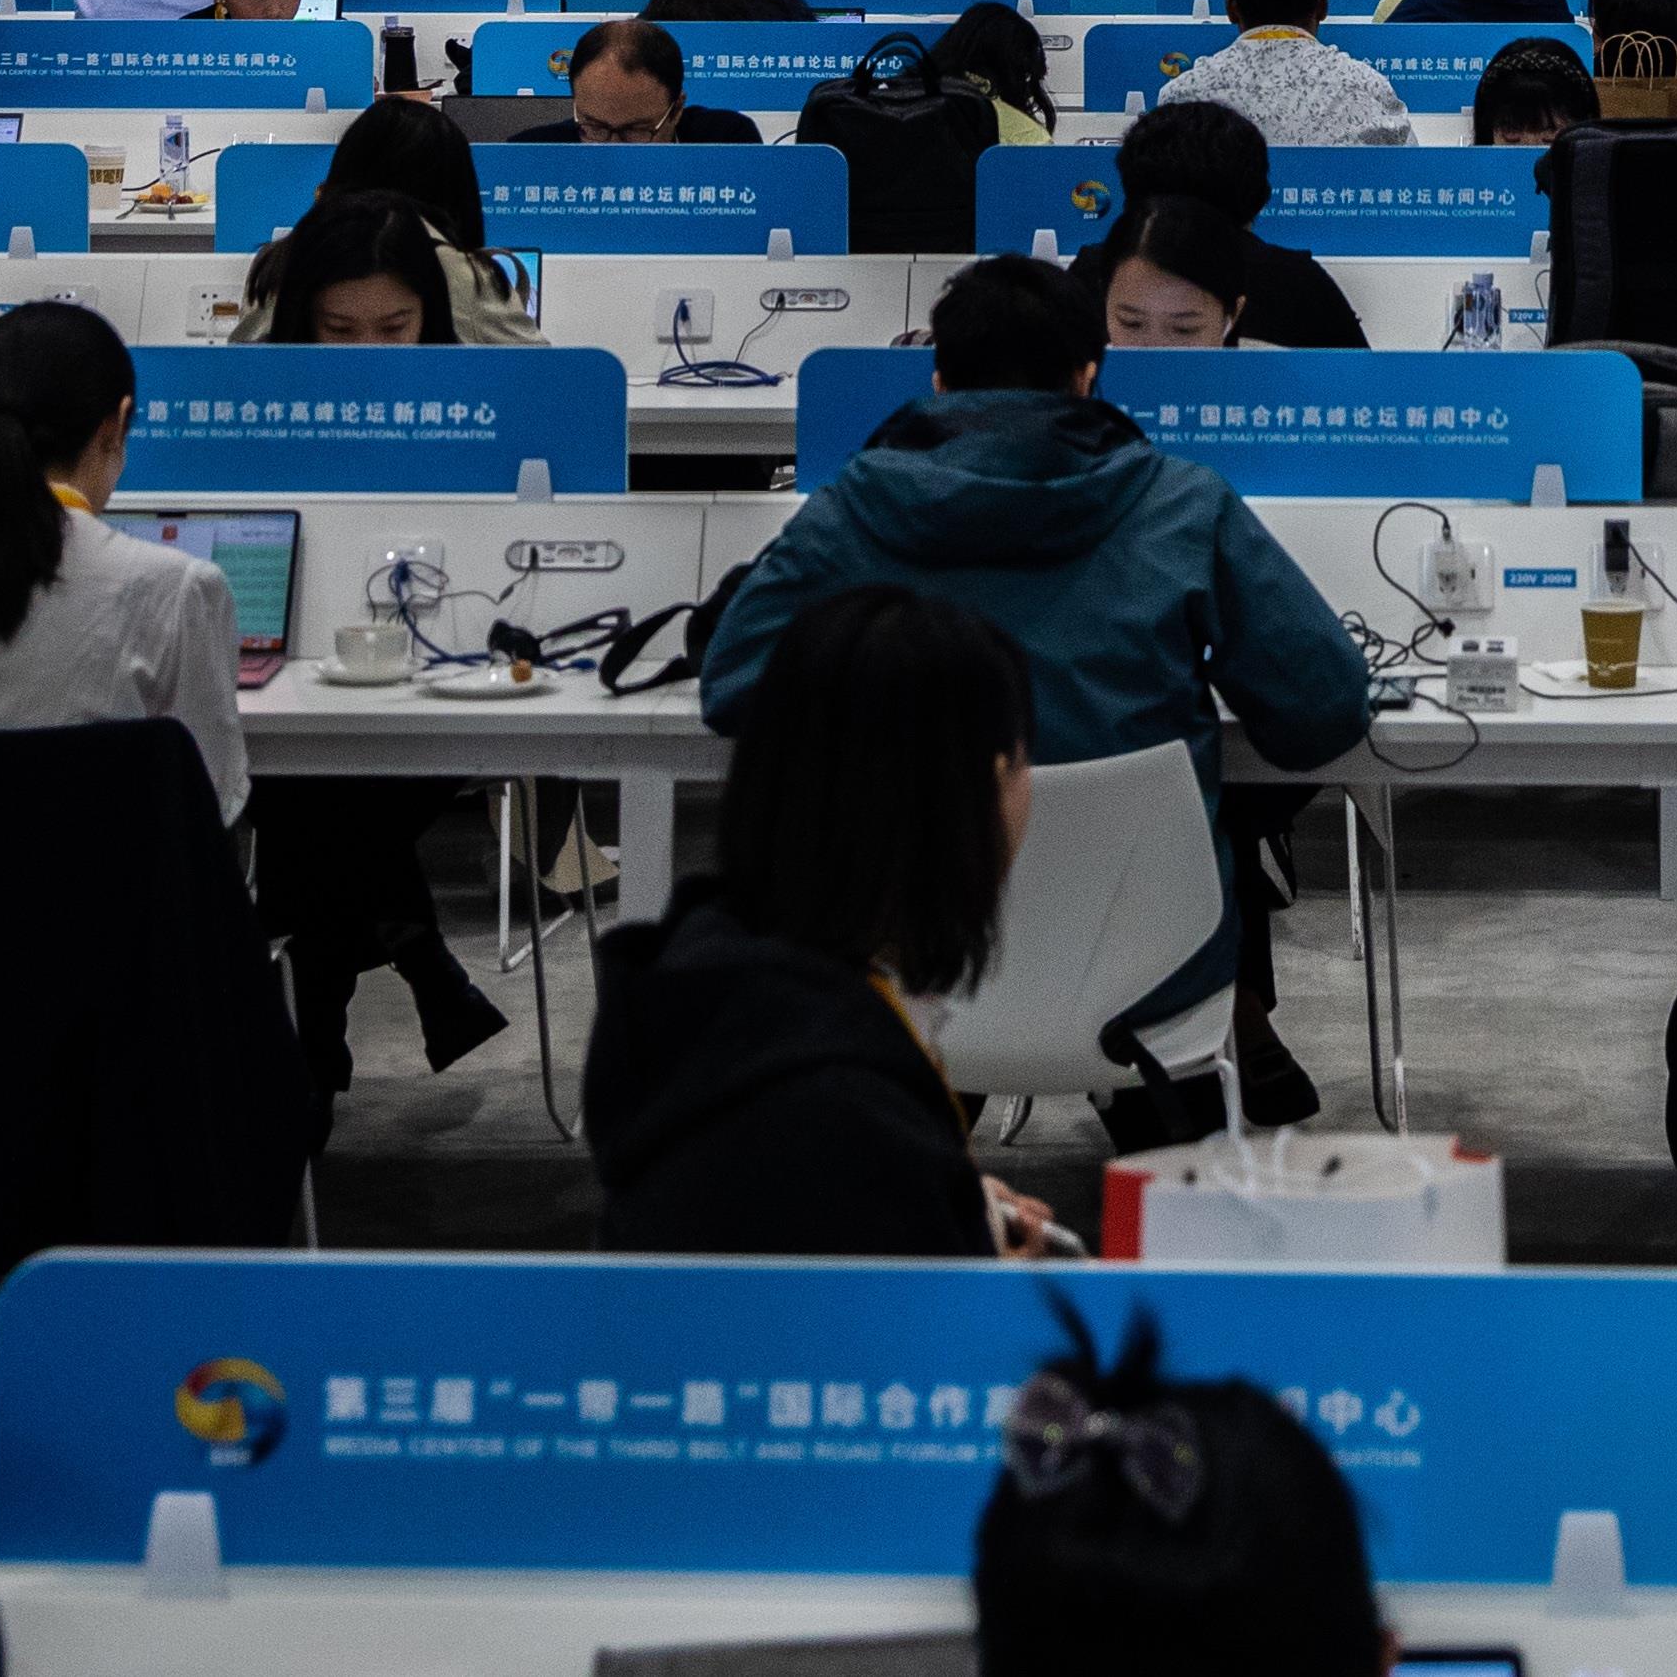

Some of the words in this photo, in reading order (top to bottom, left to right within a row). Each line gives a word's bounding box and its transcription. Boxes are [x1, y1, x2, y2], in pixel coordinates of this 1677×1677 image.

[495, 206, 517, 215] BELT
[519, 206, 538, 215] AND
[540, 206, 566, 215] ROAD
[567, 206, 600, 215] FORUM
[601, 206, 620, 215] FOR
[621, 207, 690, 215] INTERNATIONAL
[692, 207, 757, 216] COOPERATION
[1279, 208, 1298, 217] AND
[1298, 208, 1325, 217] ROAD
[1325, 208, 1358, 217] FORUM
[1359, 208, 1378, 217] FOR
[1380, 208, 1449, 217] INTERNATIONAL
[1451, 209, 1516, 217] COOPERATION
